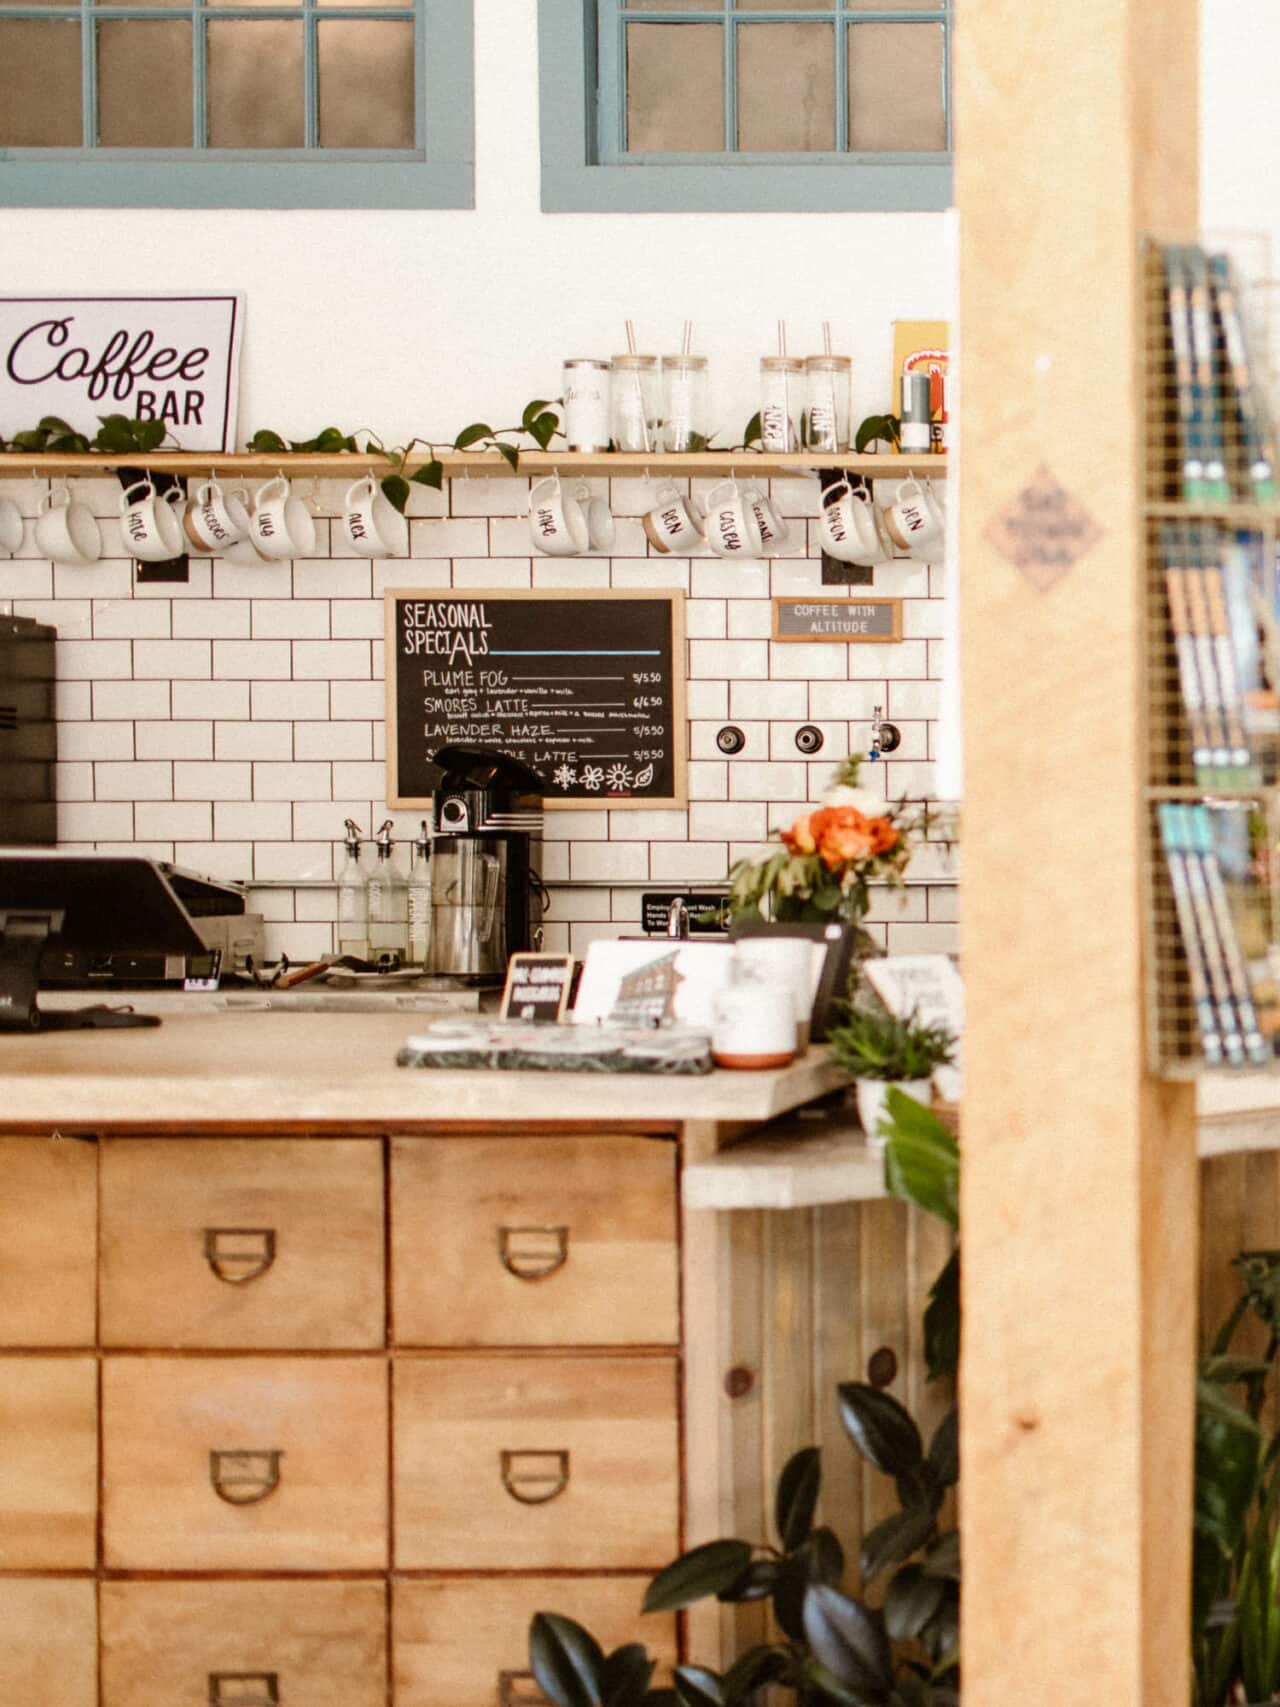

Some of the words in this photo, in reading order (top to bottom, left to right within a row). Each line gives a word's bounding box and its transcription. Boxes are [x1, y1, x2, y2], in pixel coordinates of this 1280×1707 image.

[7, 316, 210, 401] Coffee
[136, 389, 205, 426] BAR
[403, 603, 493, 629] SEASONAL
[793, 604, 839, 617] COFFEE
[847, 604, 876, 617] WITH
[810, 620, 869, 633] ALTITUDE
[403, 630, 490, 667] SPECIALS
[423, 669, 474, 687] PLUME
[479, 669, 509, 688] FOG
[423, 696, 478, 713] S'MORES
[486, 698, 529, 713] LATTE
[424, 722, 505, 737] LAVENDER
[511, 723, 556, 737] HAZE
[534, 751, 579, 762] LATTE
